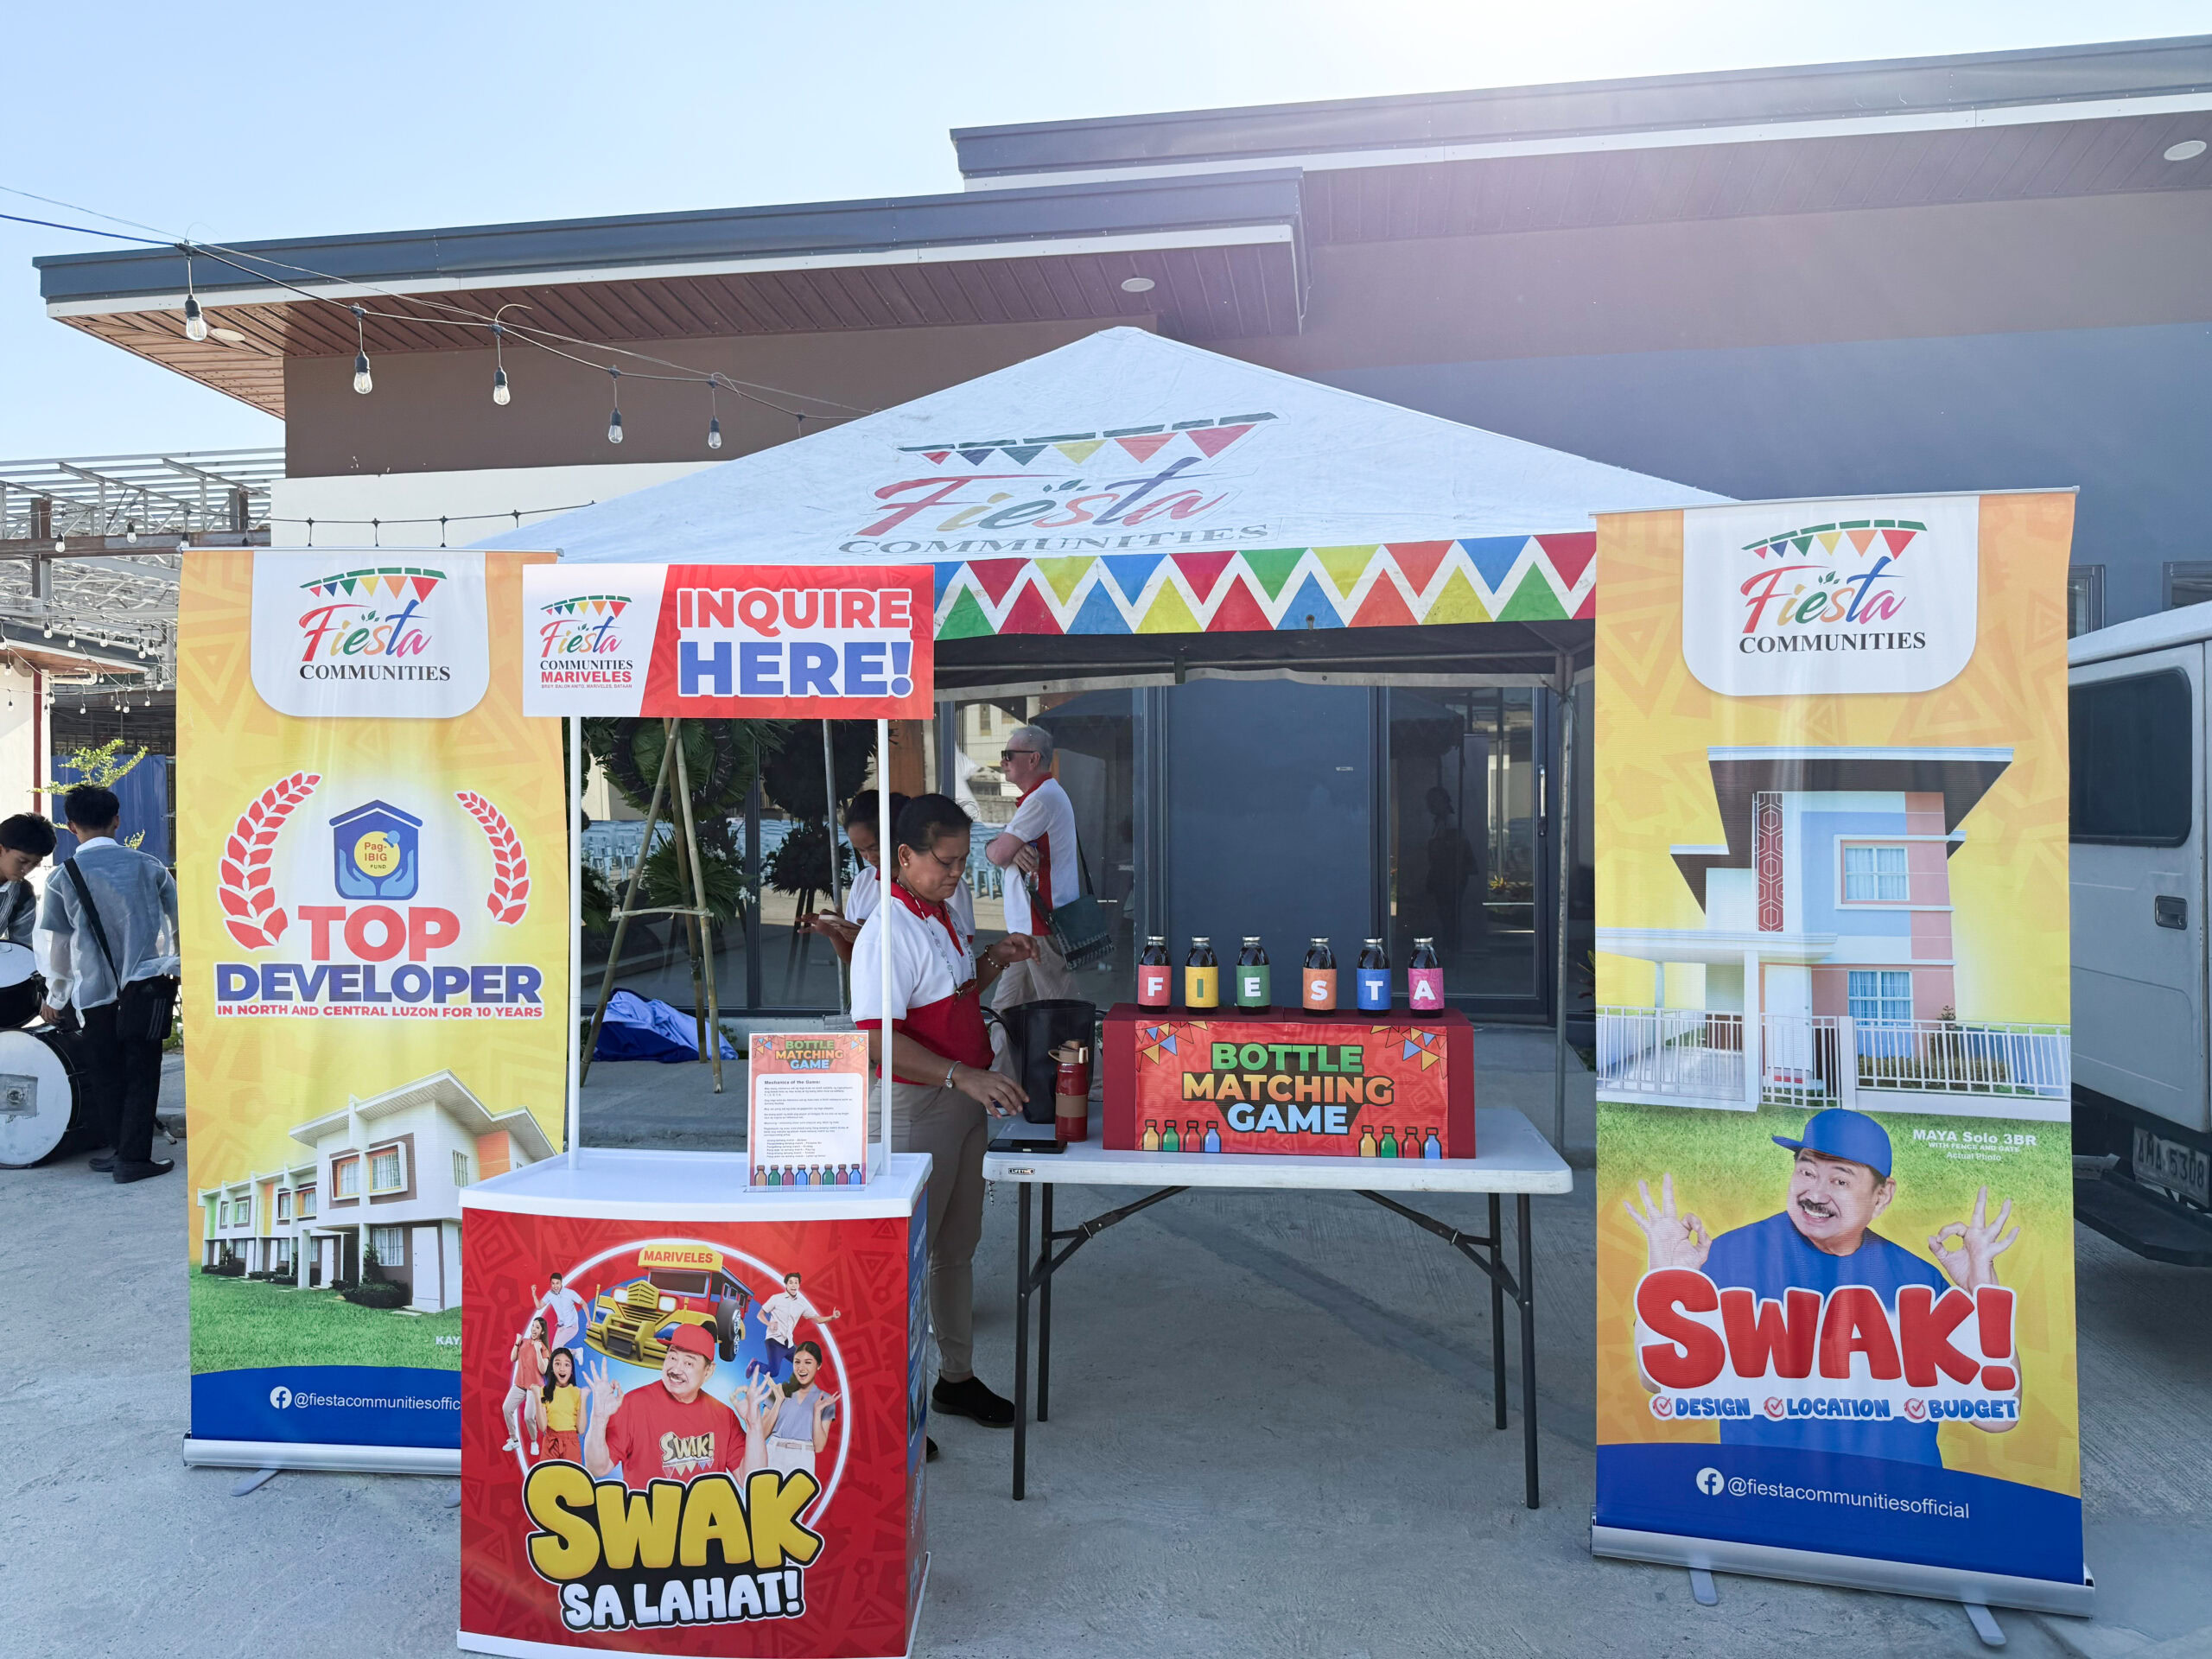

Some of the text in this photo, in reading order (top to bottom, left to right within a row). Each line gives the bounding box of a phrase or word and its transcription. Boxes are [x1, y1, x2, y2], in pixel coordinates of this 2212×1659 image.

[854, 456, 1231, 537] Fiesta
[838, 524, 1269, 555] COMMUNITIES
[1740, 556, 1906, 634] Fiesta
[678, 590, 911, 637] INQUIRE
[299, 599, 432, 662] Fiesta
[540, 615, 622, 658] Fiesta
[1739, 632, 1927, 654] COMMUNITIES
[299, 664, 451, 682] COMMUNITIES
[540, 660, 633, 670] COMMUNITIES
[541, 671, 632, 683] MARIVELES
[680, 641, 913, 696] HERE!
[365, 842, 387, 852] Pag-
[365, 853, 387, 861] IBIG
[298, 905, 461, 961] TOP
[216, 963, 543, 1004] DEVELOPER
[1147, 977, 1435, 1001] F I E S T A
[218, 1005, 543, 1018] IN NORTH AND CENTRAL LUZON FOR 10 YEARS
[775, 1050, 843, 1060] MATCHING
[785, 1040, 835, 1050] BOTTLE
[1211, 1043, 1363, 1073] BOTTLE
[790, 1059, 830, 1070] GAME
[1183, 1074, 1394, 1104] MATCHING
[1227, 1103, 1348, 1135] GAME
[1913, 1129, 2037, 1146] MAYA Solo 3BR
[1947, 1152, 2002, 1161] Actual Photo
[644, 1250, 714, 1263] MARIVELES
[435, 1335, 462, 1345] KAY
[1636, 1268, 2017, 1391] SWAK!
[1675, 1397, 2017, 1420] DESIGN LOCATION BUDGET
[1728, 1477, 1970, 1520] @fiestacommunitiesofficial
[526, 1465, 823, 1580] SWAK
[563, 1571, 800, 1626] SA LAHAT!
